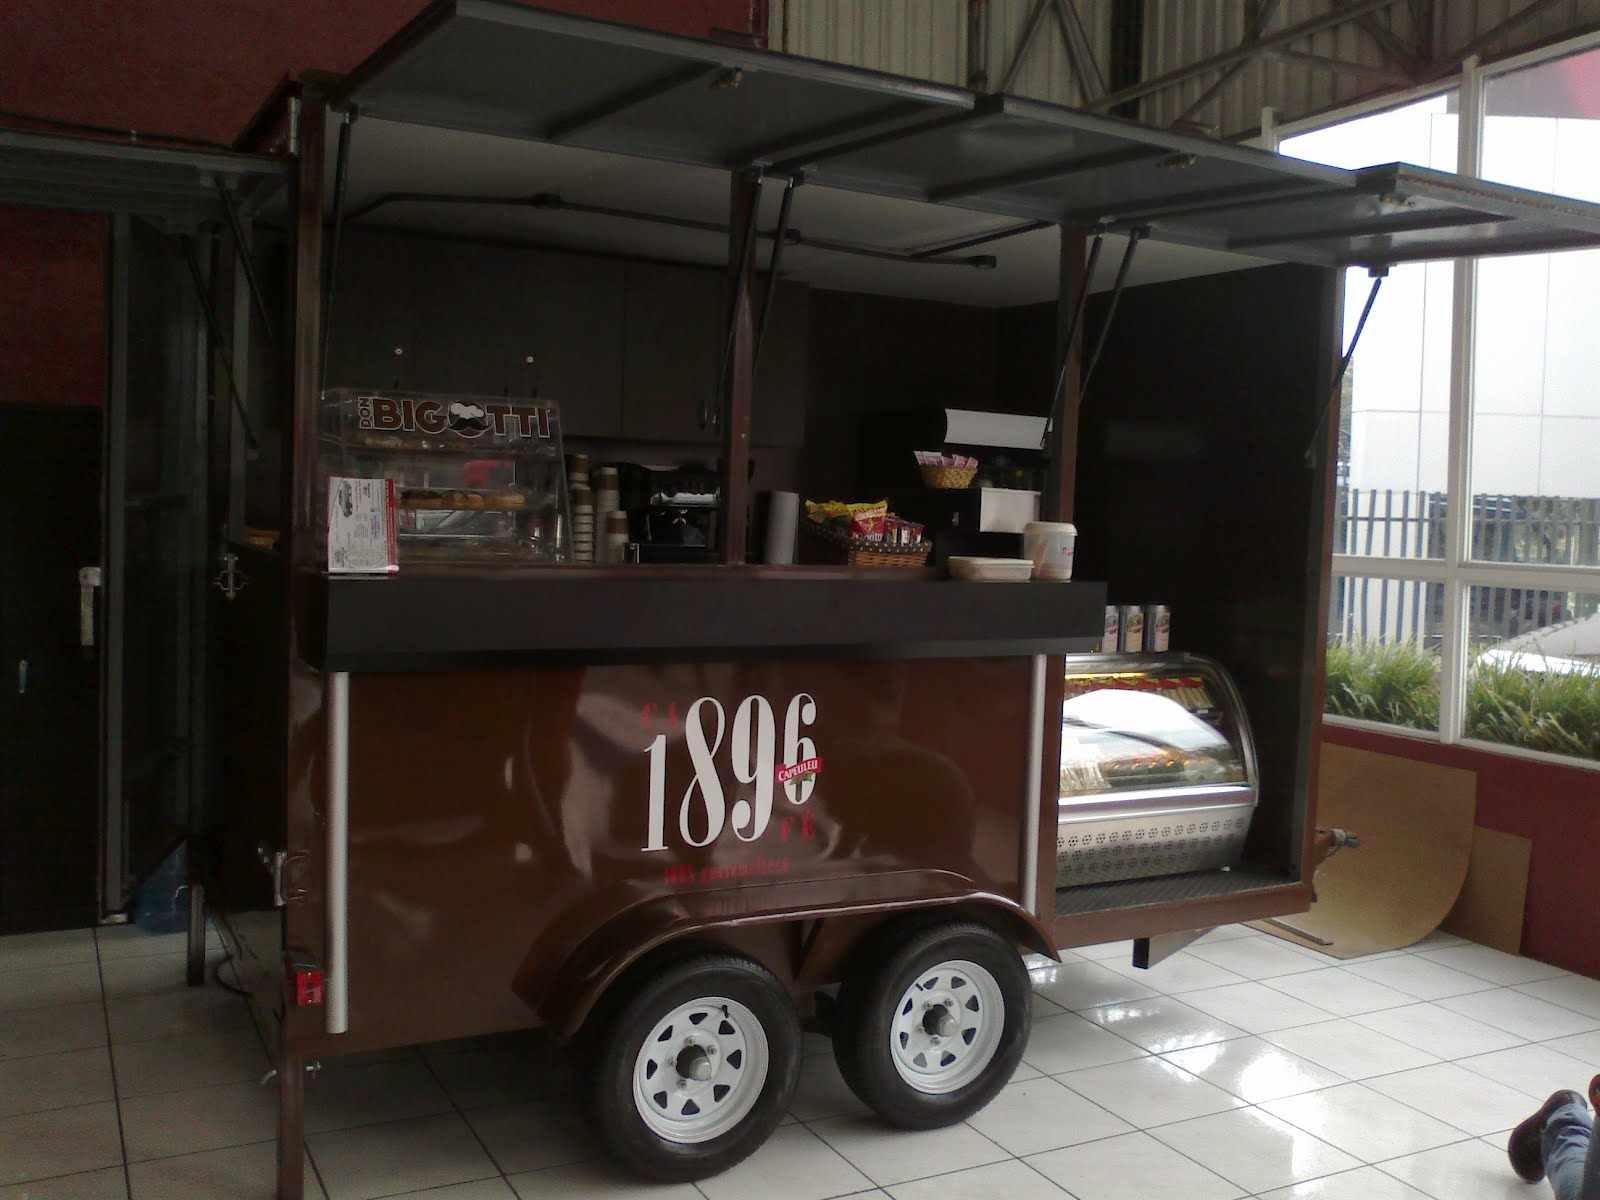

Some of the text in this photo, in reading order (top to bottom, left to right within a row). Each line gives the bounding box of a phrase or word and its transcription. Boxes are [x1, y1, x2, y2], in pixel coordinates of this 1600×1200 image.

[359, 396, 373, 429] DON
[373, 398, 550, 439] BIGOTTI
[641, 692, 817, 852] 1896
